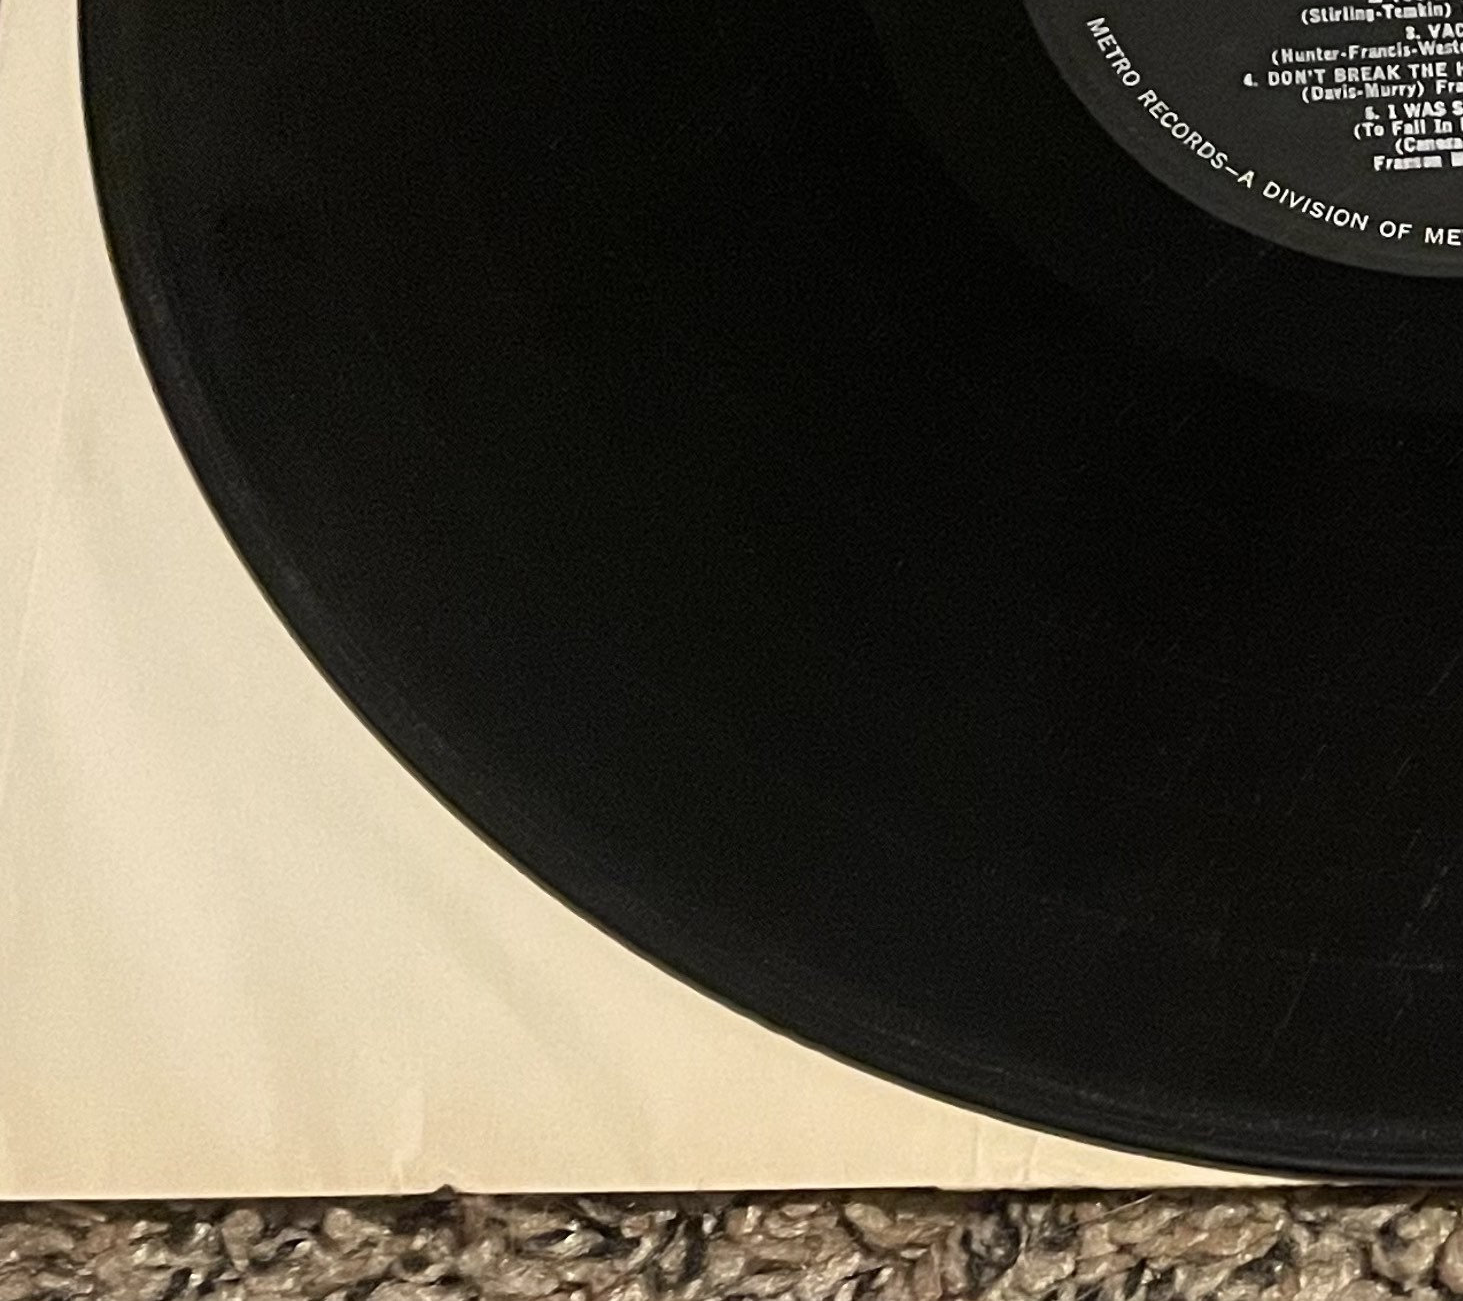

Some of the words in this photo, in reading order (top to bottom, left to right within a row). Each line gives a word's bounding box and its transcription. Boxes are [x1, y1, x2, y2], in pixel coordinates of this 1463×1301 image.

[1268, 68, 1325, 86] DON'T
[1334, 64, 1401, 84] BREAK
[1407, 62, 1447, 79] THE
[1302, 80, 1425, 104] (Davis-Murry)
[1403, 100, 1448, 119] WAS
[1086, 16, 1142, 88] METRO
[1262, 180, 1370, 232] DIVISION
[1379, 220, 1413, 240] OF
[1354, 121, 1385, 141] (To
[1391, 118, 1426, 137] Fall
[1434, 119, 1452, 135] In
